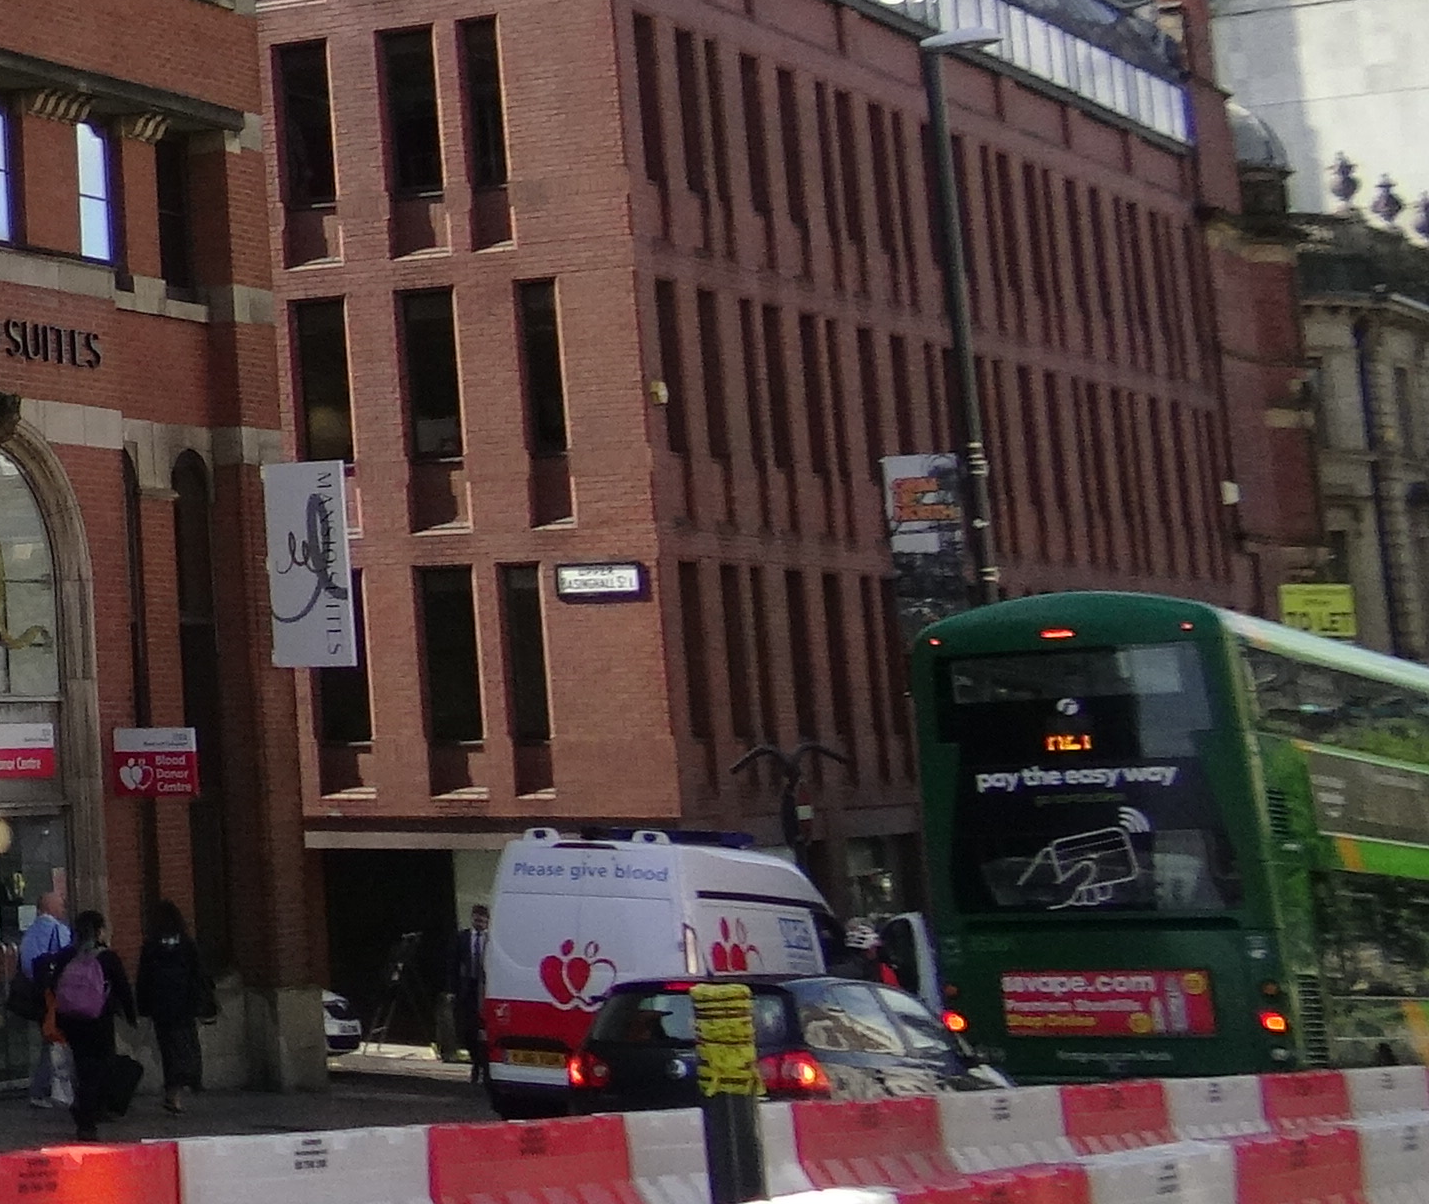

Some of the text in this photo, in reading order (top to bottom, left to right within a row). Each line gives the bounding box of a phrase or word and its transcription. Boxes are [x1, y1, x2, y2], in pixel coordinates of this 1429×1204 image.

[5, 318, 102, 369] SUITES
[155, 755, 186, 765] Blood
[155, 768, 189, 779] Donor
[975, 765, 1180, 793] pay the easy way
[157, 781, 193, 793] Centre
[513, 860, 669, 883] Please give blood
